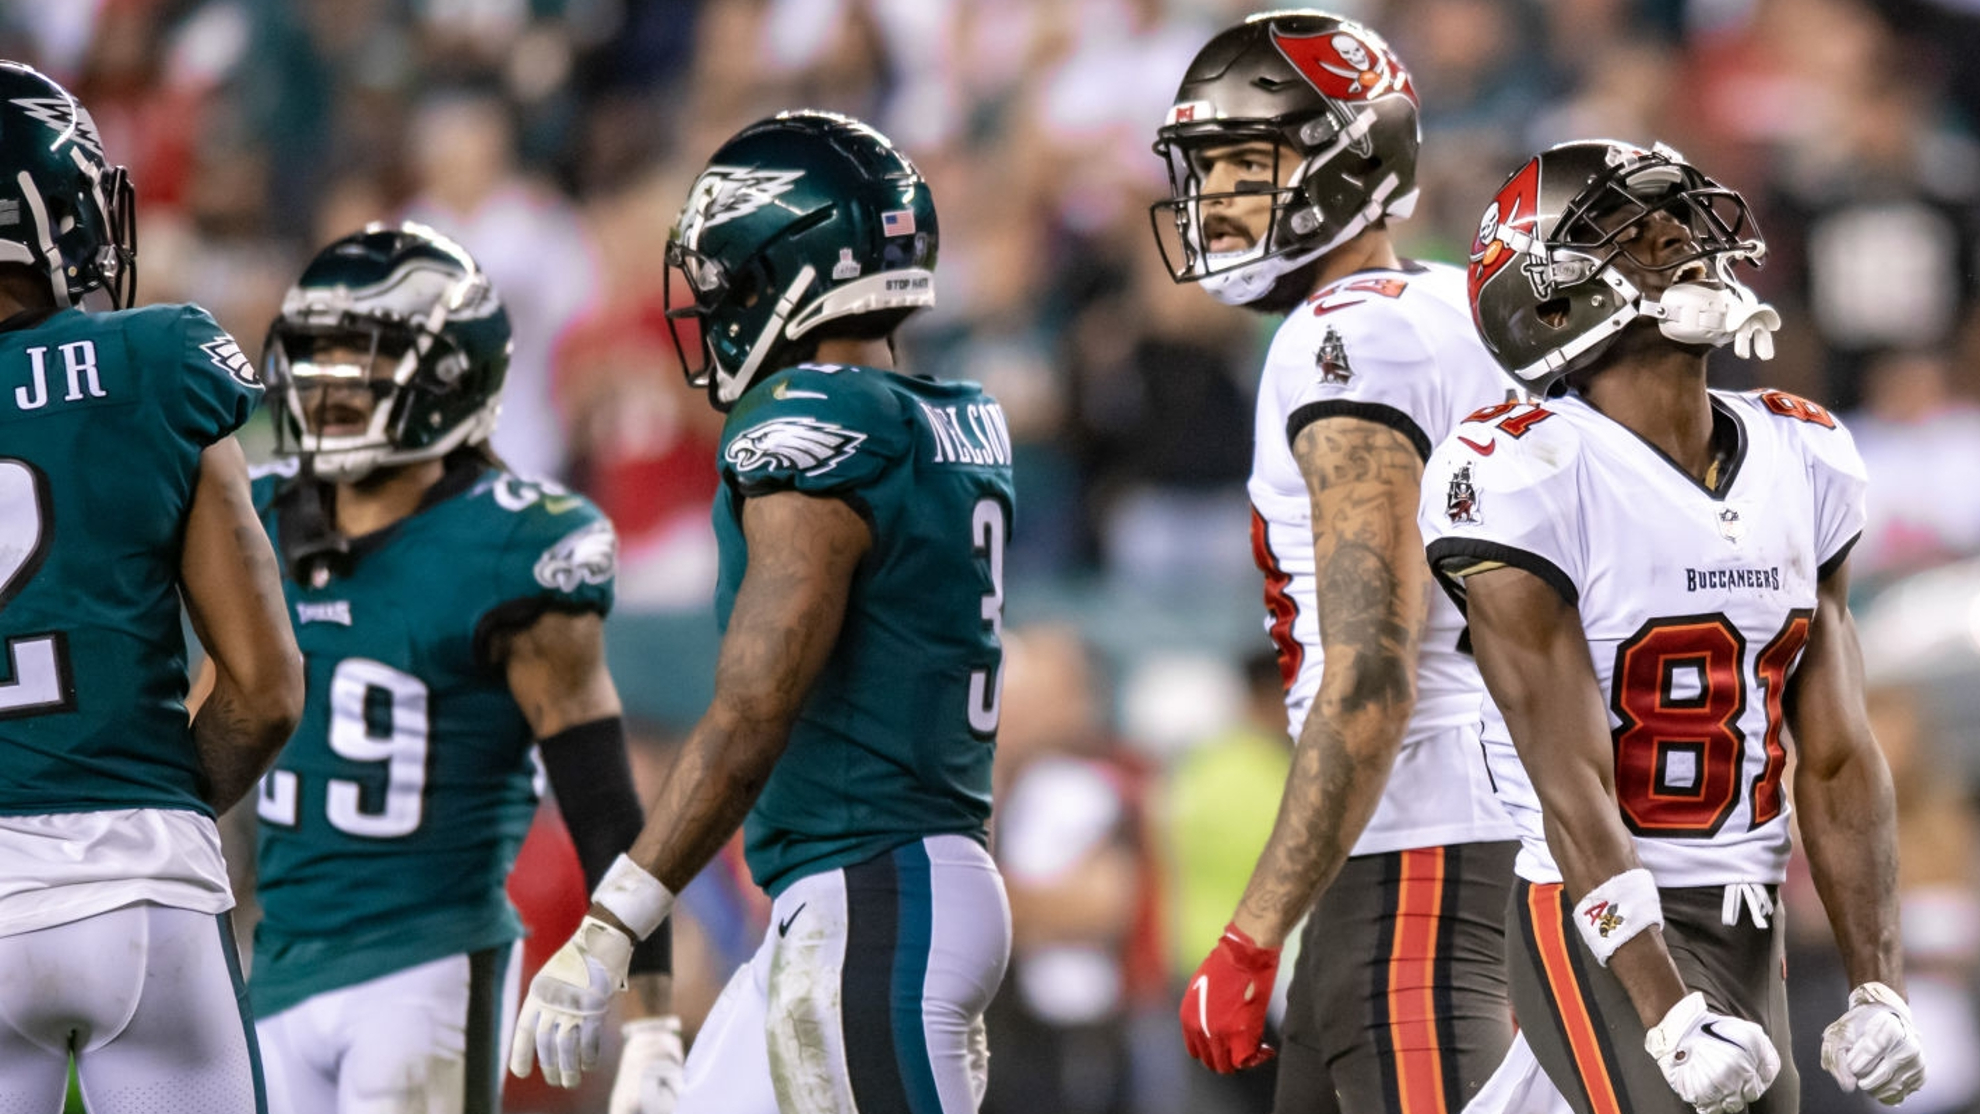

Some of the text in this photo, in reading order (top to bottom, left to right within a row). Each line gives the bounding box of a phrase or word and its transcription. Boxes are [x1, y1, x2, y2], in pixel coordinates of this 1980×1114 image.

[886, 279, 910, 290] STOP
[15, 340, 107, 410] JR
[920, 403, 1011, 466] NELSON
[1685, 567, 1780, 593] BUCCANEERS
[967, 499, 1004, 734] 3
[1610, 608, 1814, 839] 81
